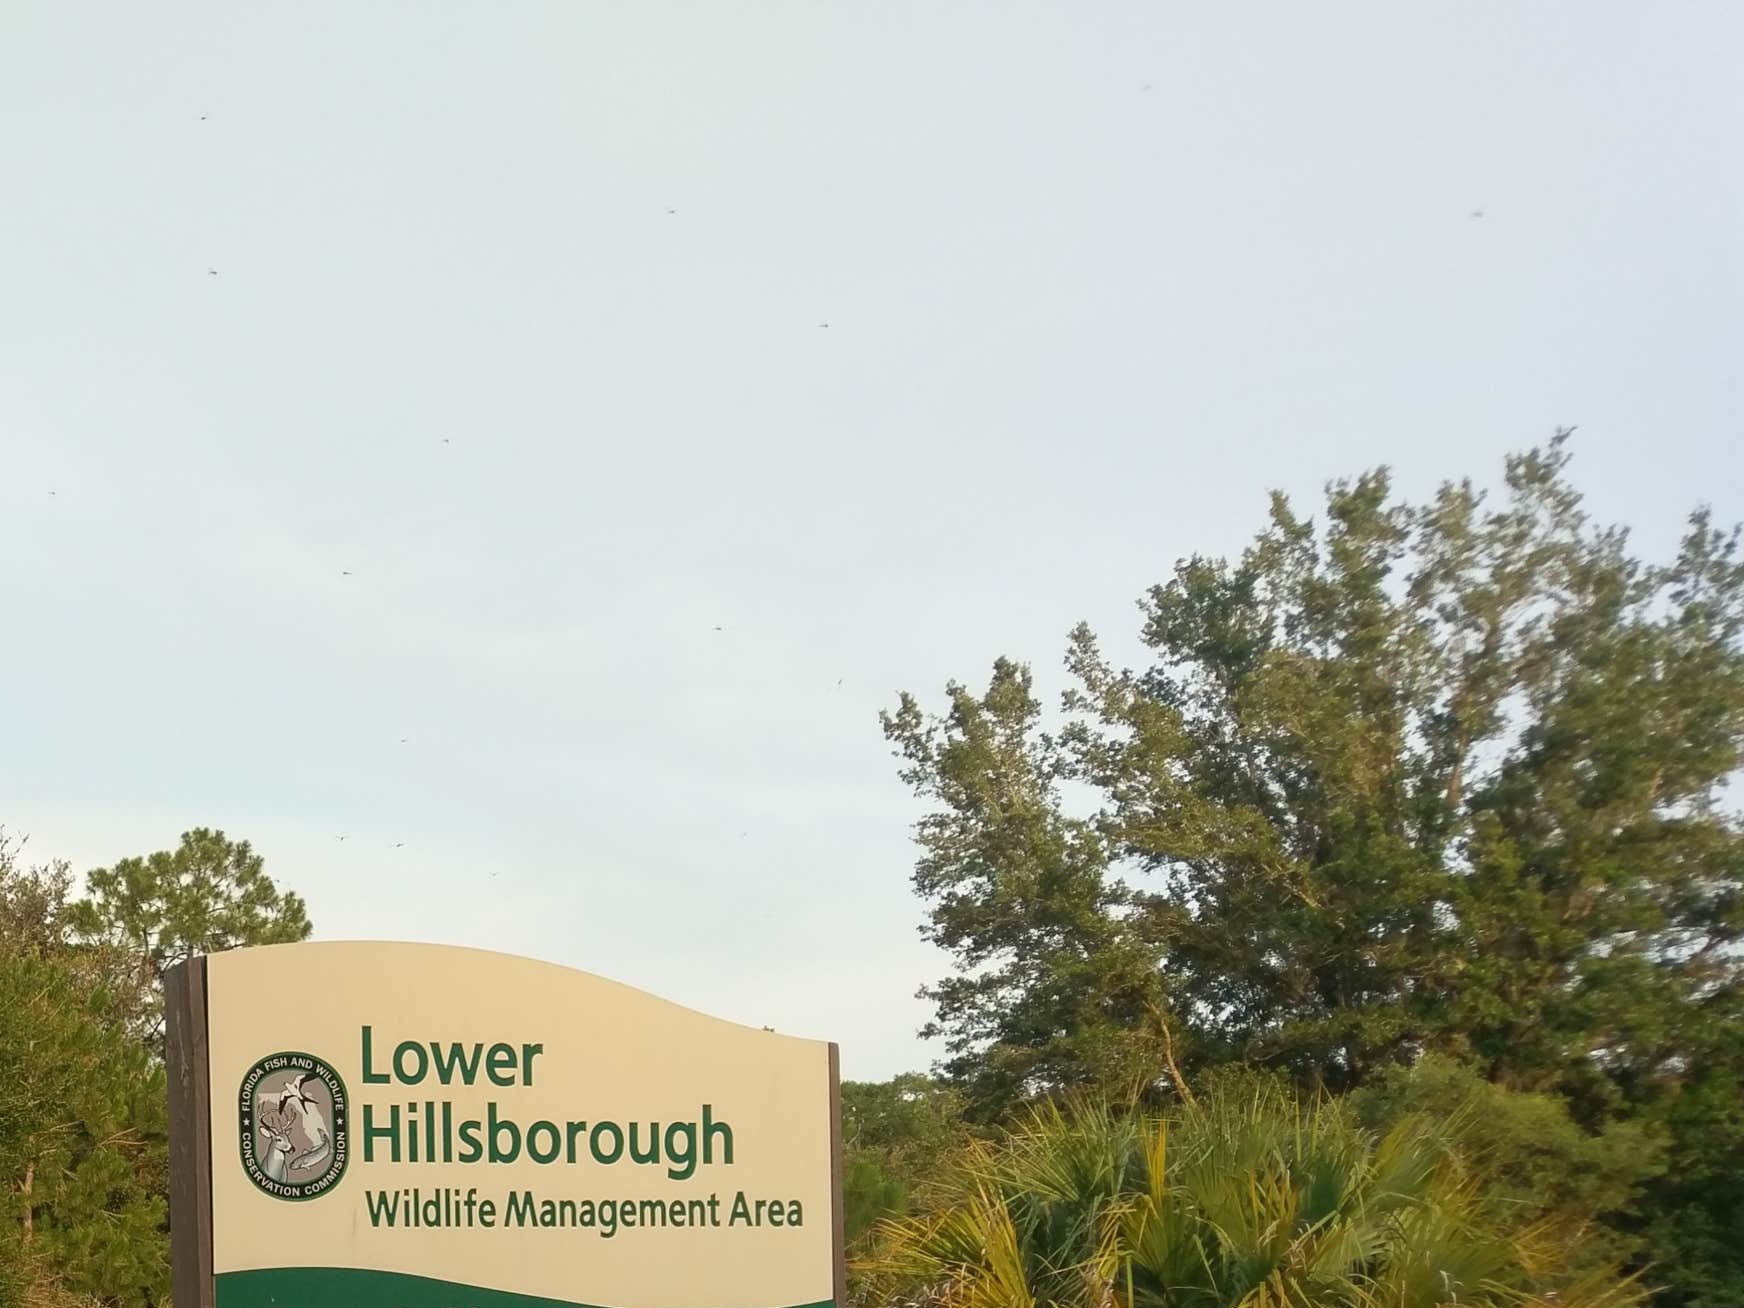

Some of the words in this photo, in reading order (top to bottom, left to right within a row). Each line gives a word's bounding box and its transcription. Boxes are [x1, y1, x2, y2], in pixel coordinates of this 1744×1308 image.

[242, 1068, 263, 1111] FLORIDA
[264, 1058, 287, 1072] FISH
[291, 1058, 313, 1069] AND
[316, 1064, 344, 1110] WILDLIFE
[361, 1025, 543, 1086] Lower
[242, 1132, 300, 1196] CONSERVATION
[305, 1132, 345, 1195] COMMISSION
[363, 1102, 734, 1180] Hillsborough
[365, 1189, 496, 1228] Wildlife
[504, 1191, 720, 1238] Management
[729, 1192, 803, 1227] Area
